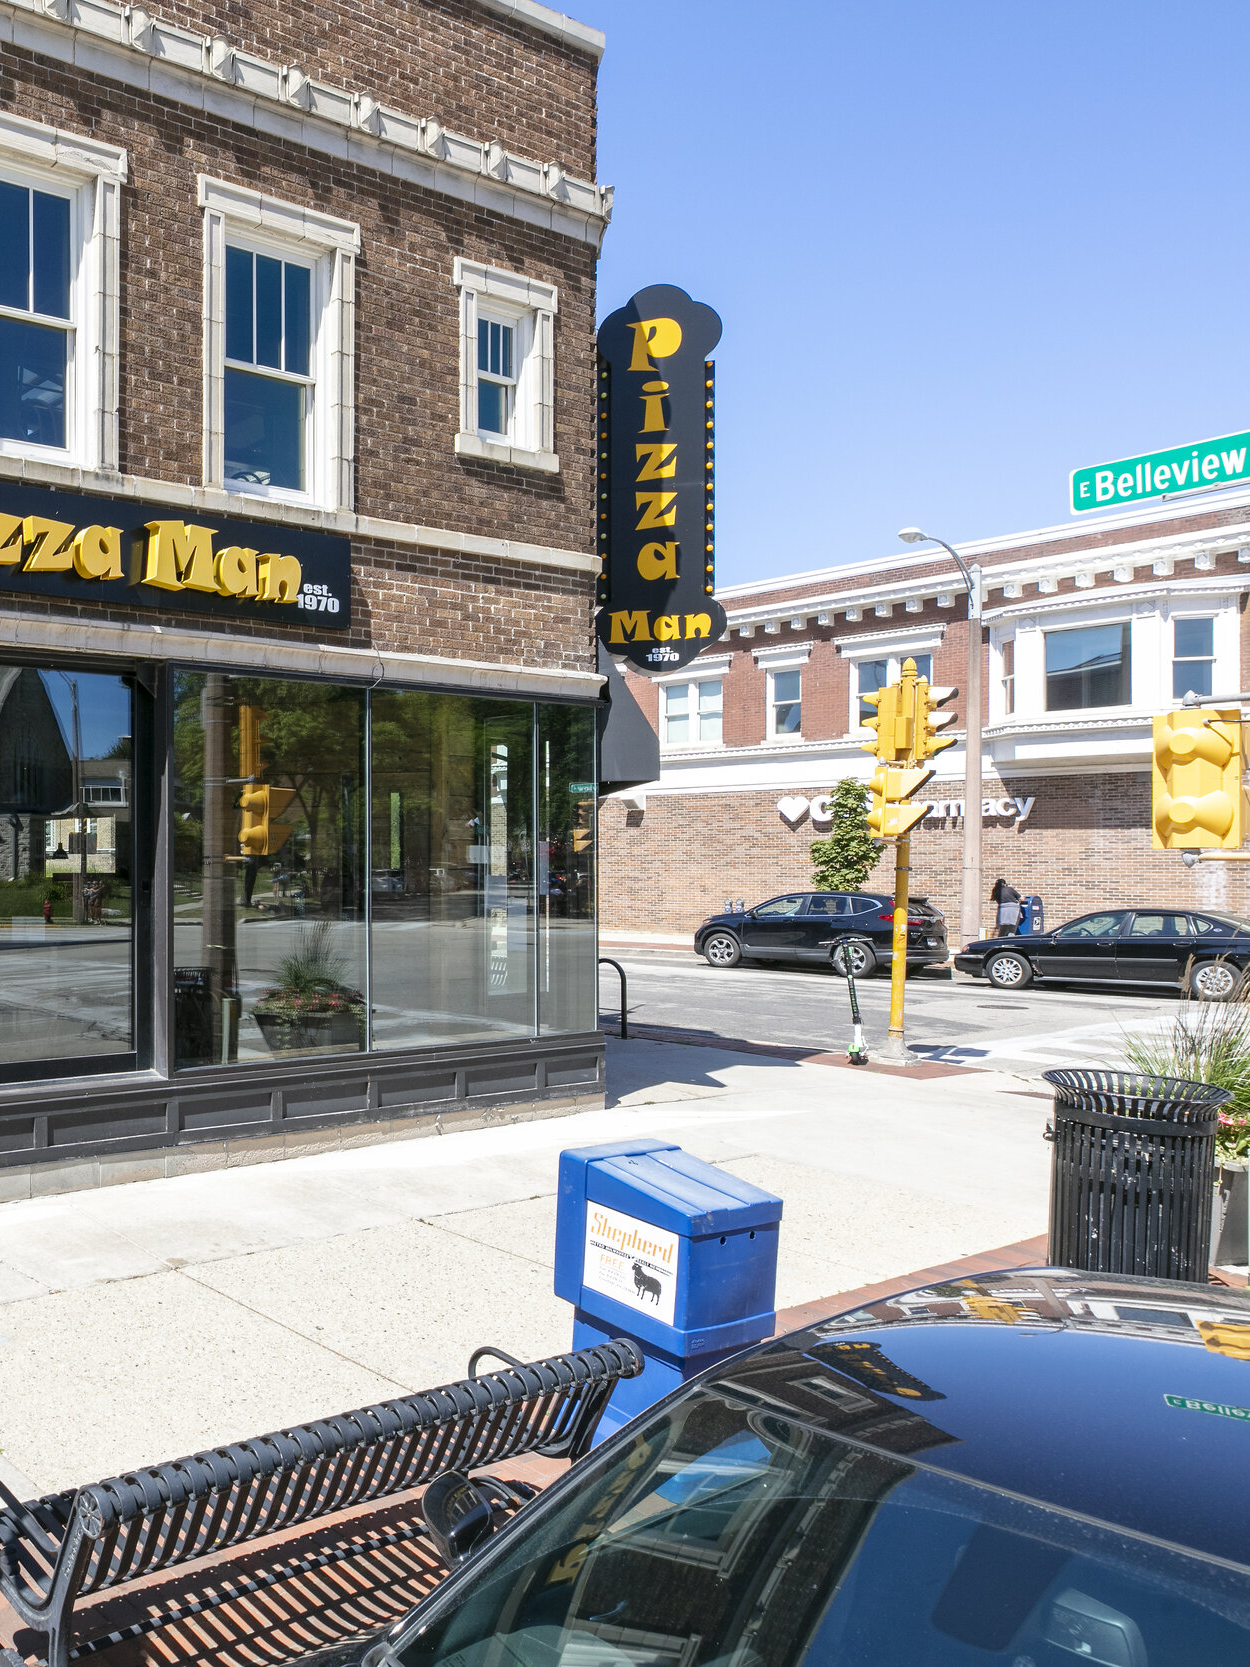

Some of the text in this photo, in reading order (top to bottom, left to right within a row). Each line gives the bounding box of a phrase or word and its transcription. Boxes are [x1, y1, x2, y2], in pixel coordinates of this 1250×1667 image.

[626, 317, 683, 581] Pizza
[1080, 447, 1247, 501] E Belleview
[141, 519, 303, 604] Man
[296, 593, 340, 613] 1970
[303, 583, 332, 597] est.
[608, 609, 712, 644] Man
[646, 652, 680, 662] 1970
[591, 1212, 674, 1264] Shepherd
